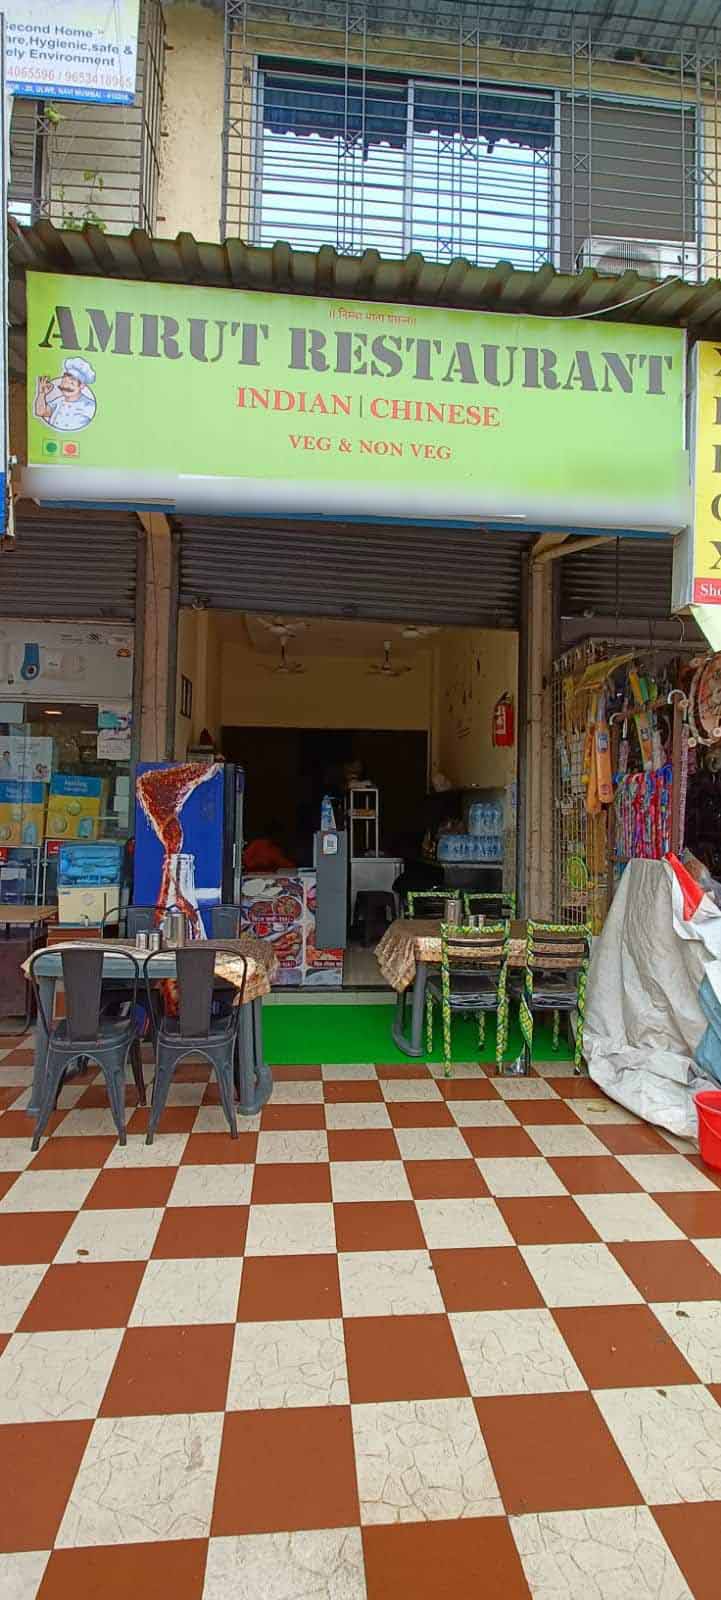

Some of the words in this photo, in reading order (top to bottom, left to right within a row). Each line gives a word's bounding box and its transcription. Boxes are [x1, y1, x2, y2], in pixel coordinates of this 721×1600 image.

[55, 25, 93, 38] Home
[30, 49, 115, 66] Environment
[123, 45, 133, 55] &
[38, 305, 269, 366] AMRUT
[288, 327, 673, 396] RESTAURANT
[236, 386, 352, 415] INDIAN
[370, 398, 500, 427] CHINESE
[288, 434, 331, 451] VEG
[338, 438, 352, 453] &
[359, 439, 402, 457] NON
[410, 443, 451, 460] VEG
